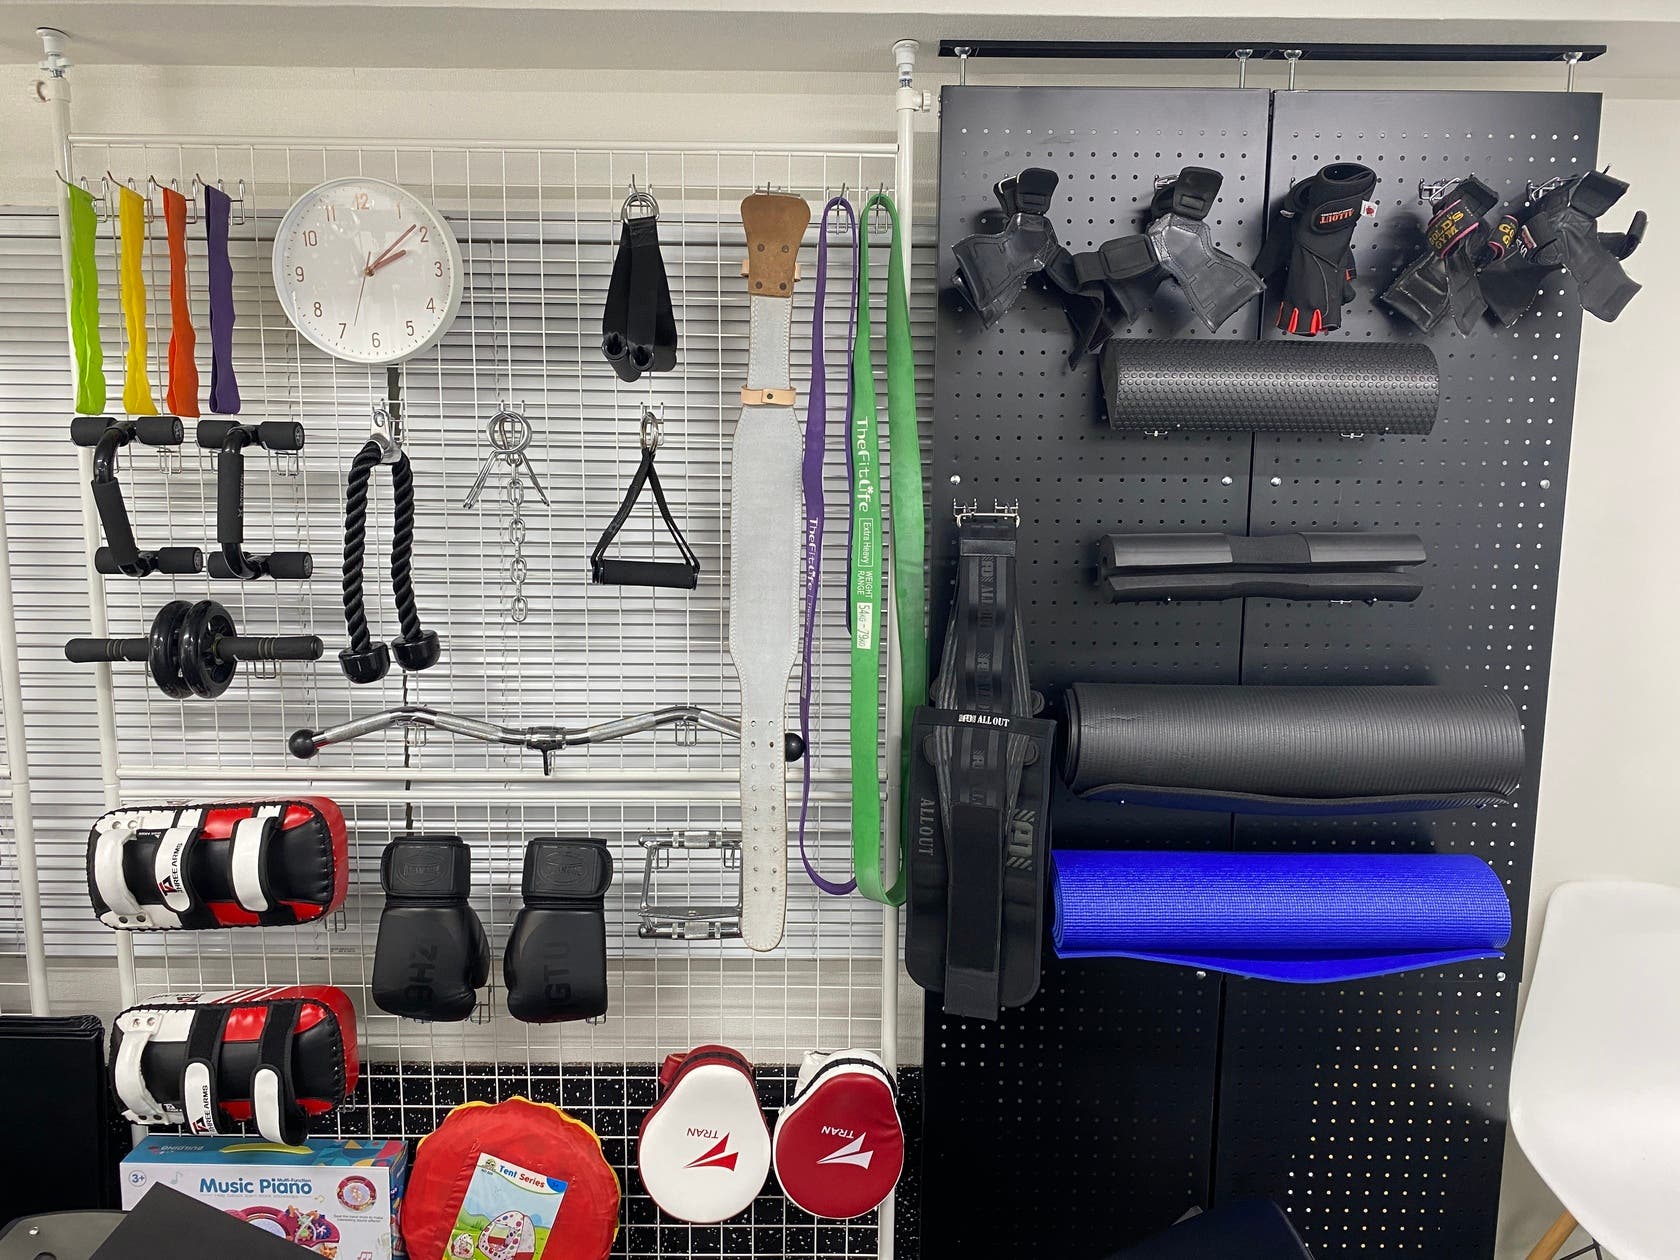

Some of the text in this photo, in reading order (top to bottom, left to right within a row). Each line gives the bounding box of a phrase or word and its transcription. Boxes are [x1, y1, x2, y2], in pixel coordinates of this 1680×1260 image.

[354, 192, 370, 210] 12
[326, 206, 336, 222] 11
[396, 204, 402, 220] 1
[302, 230, 317, 246] 10
[420, 226, 428, 242] 2
[1435, 224, 1459, 249] GYM
[296, 266, 304, 282] 9
[434, 262, 443, 277] 3
[314, 302, 322, 317] 8
[426, 298, 436, 313] 4
[339, 323, 346, 339] 7
[406, 321, 414, 336] 5
[372, 332, 380, 348] 6
[861, 522, 871, 563] Extra Heavy
[976, 715, 992, 724] ALL
[993, 717, 1010, 727] OUT
[919, 798, 936, 856] ALL OUT
[172, 843, 183, 867] ARMS
[687, 1128, 718, 1139] TRAN
[821, 1126, 854, 1139] TRAN
[132, 1174, 144, 1183] 3+
[499, 1165, 517, 1178] Tent
[519, 1173, 545, 1188] Series
[200, 1178, 312, 1194] Music Piano
